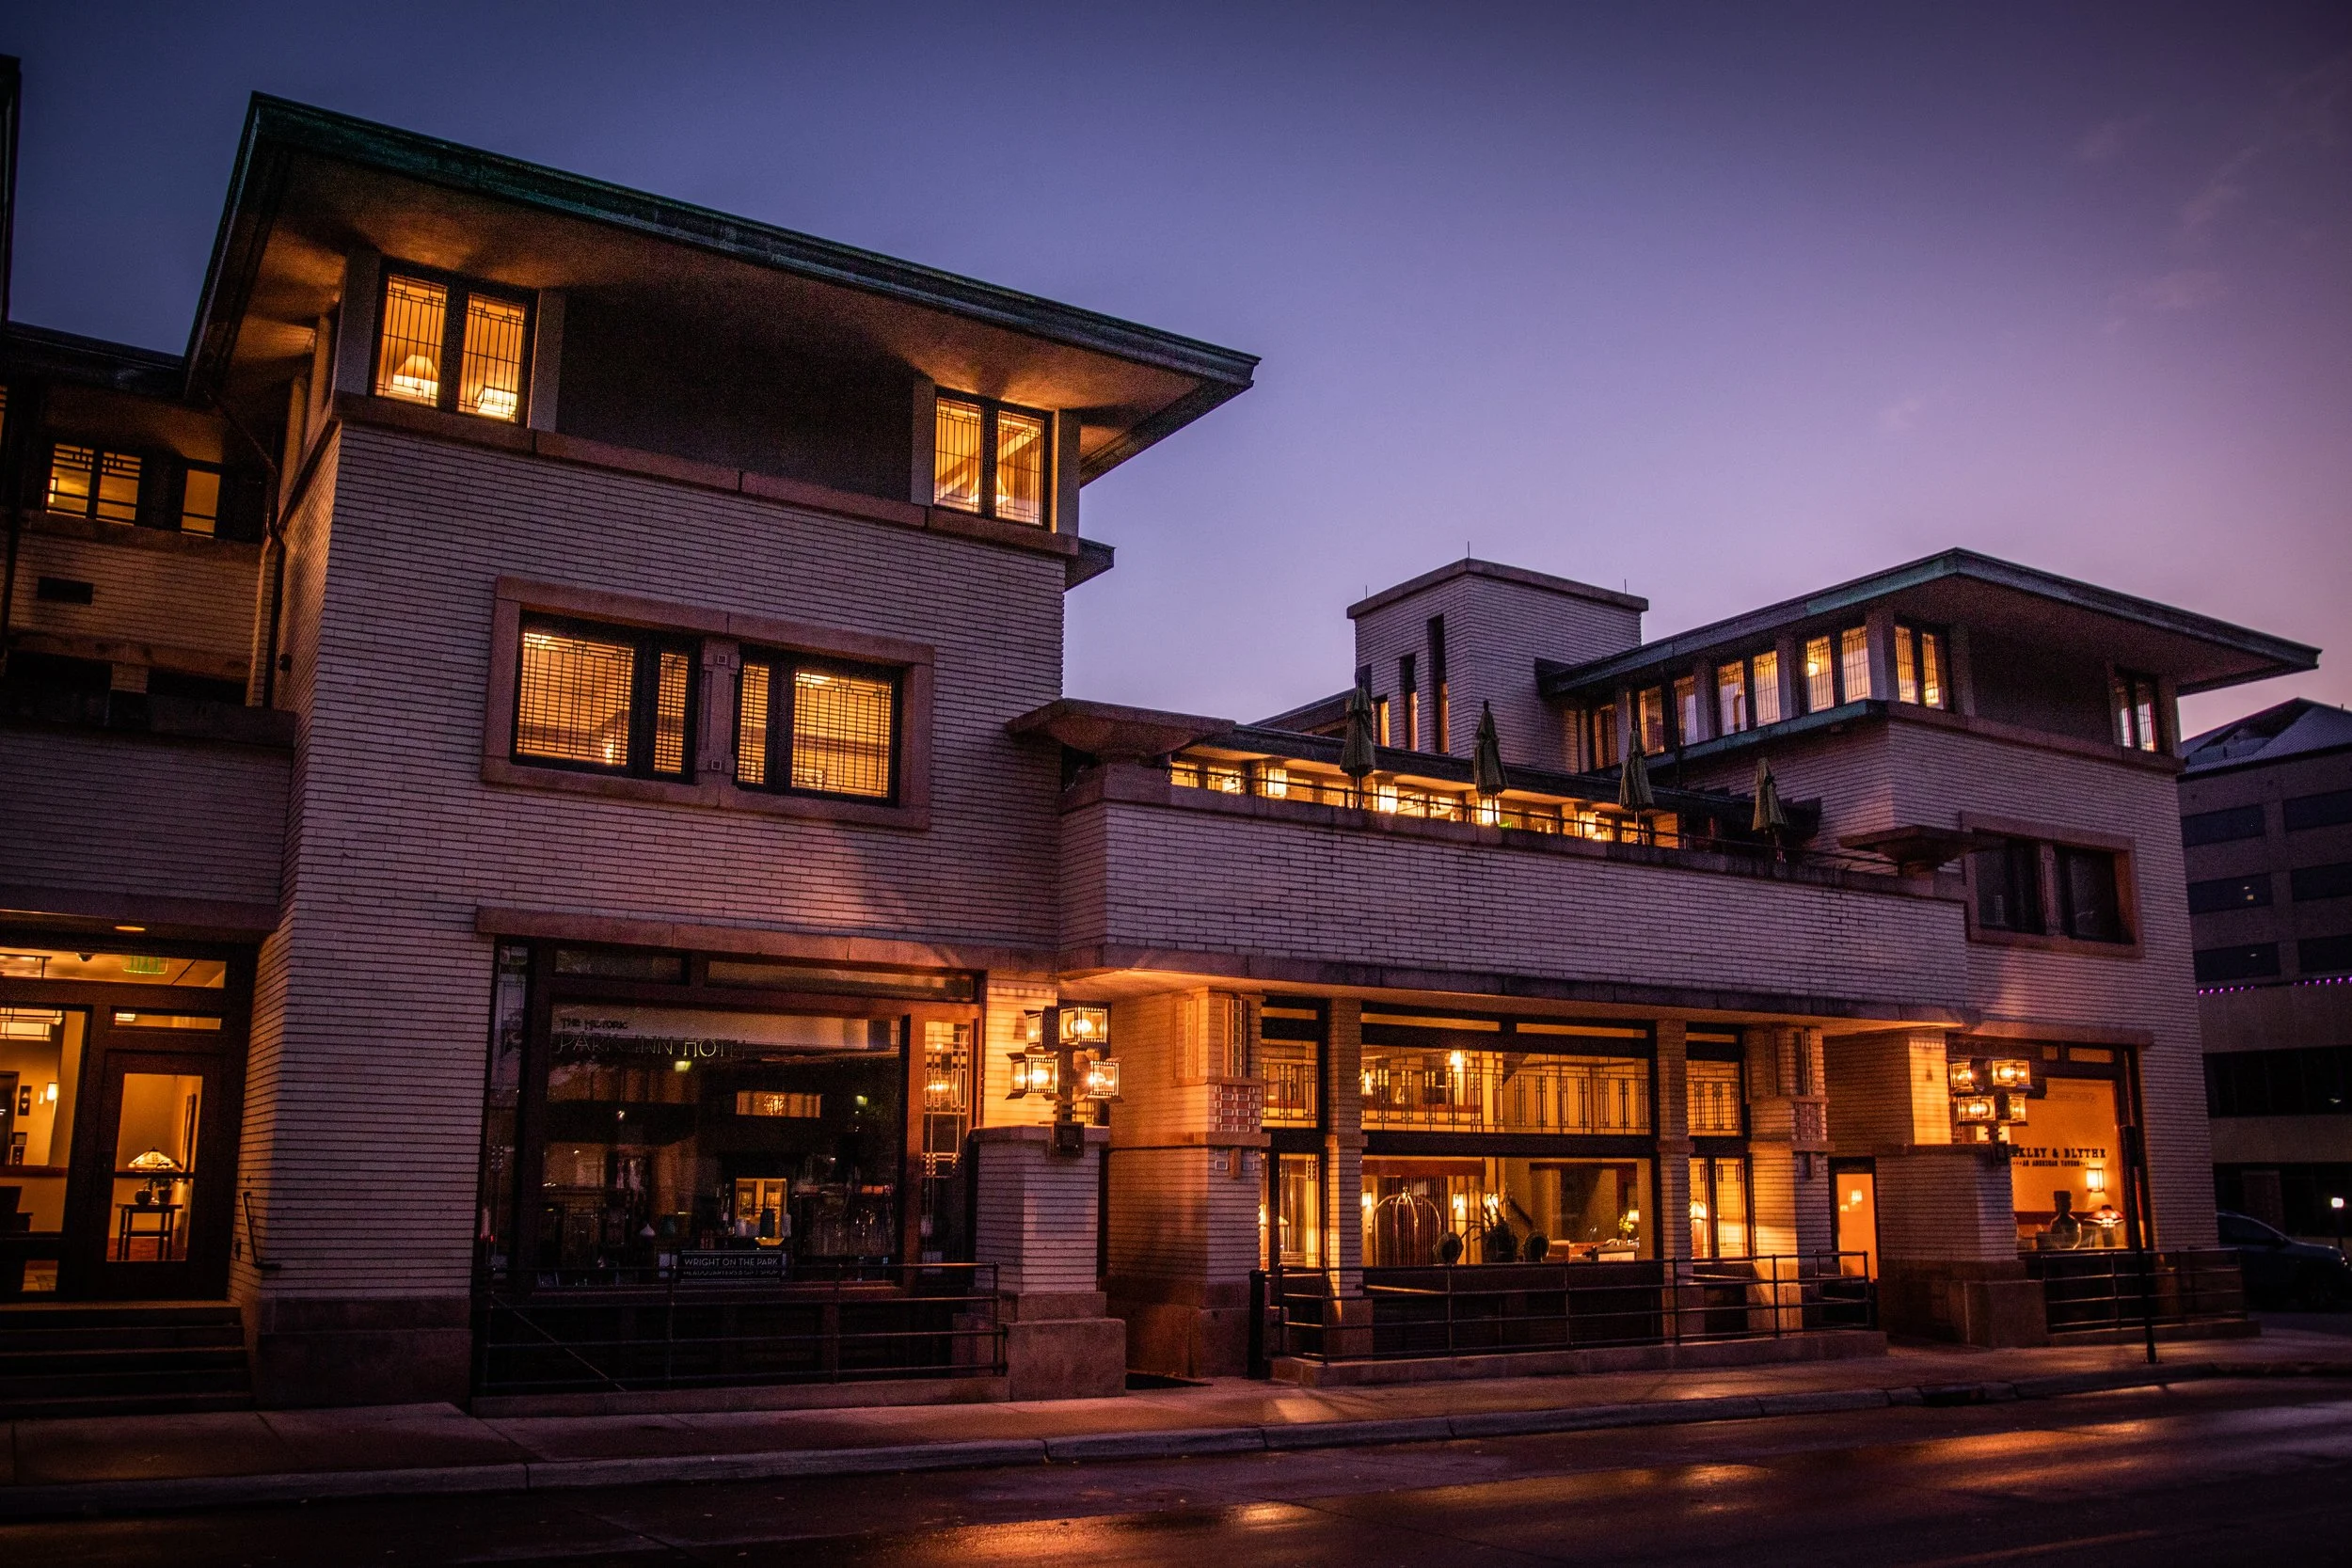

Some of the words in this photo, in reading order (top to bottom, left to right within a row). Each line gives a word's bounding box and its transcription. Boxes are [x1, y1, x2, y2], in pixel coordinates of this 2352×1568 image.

[553, 1031, 625, 1054] PARK
[635, 1035, 674, 1055] INN
[2052, 1148, 2059, 1158] &
[2063, 1148, 2106, 1159] BLYTHE
[684, 1258, 720, 1266] WRIGHT
[722, 1258, 737, 1266] ON
[738, 1258, 755, 1266] THE
[756, 1258, 779, 1266] PARK
